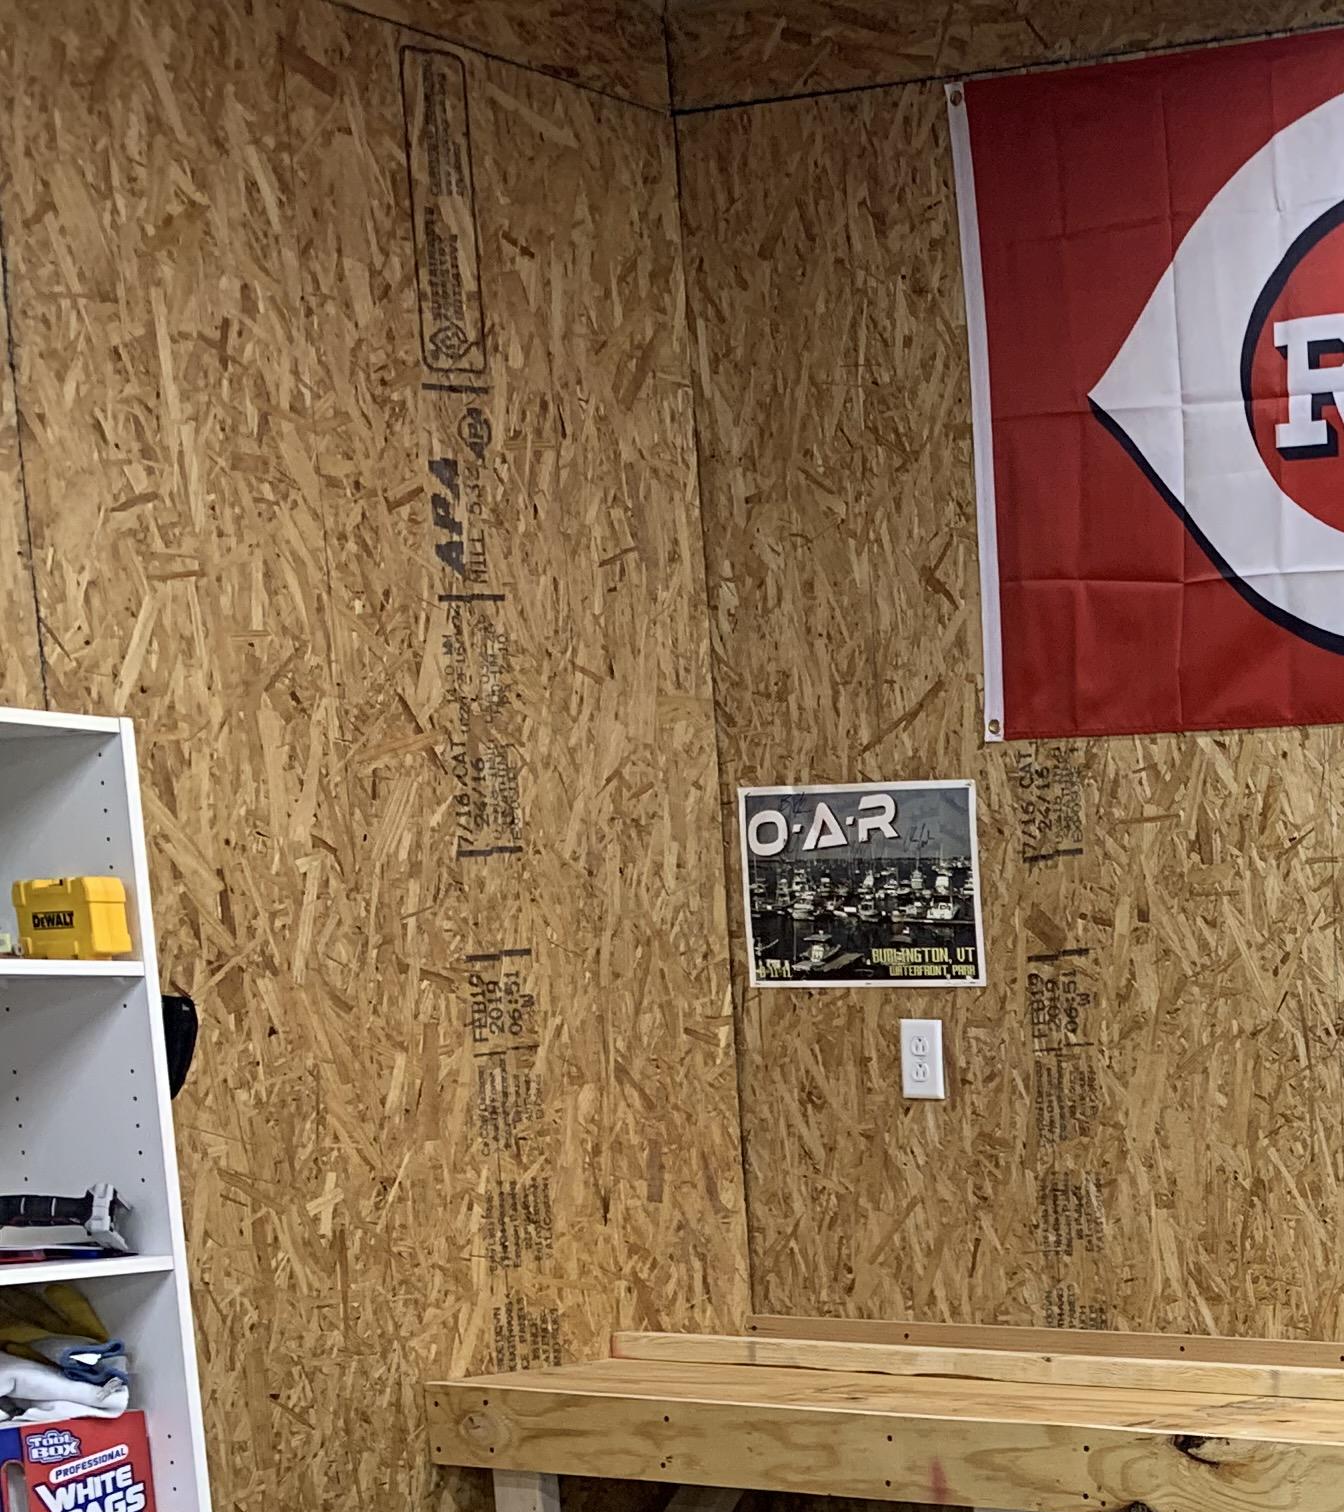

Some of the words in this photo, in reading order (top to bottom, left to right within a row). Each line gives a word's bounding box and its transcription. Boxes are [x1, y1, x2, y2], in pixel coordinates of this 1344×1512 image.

[1034, 766, 1053, 833] 24/16
[486, 980, 506, 1036] 2019
[31, 1442, 80, 1460] BOX
[55, 1447, 126, 1480] PROFESSIONAL
